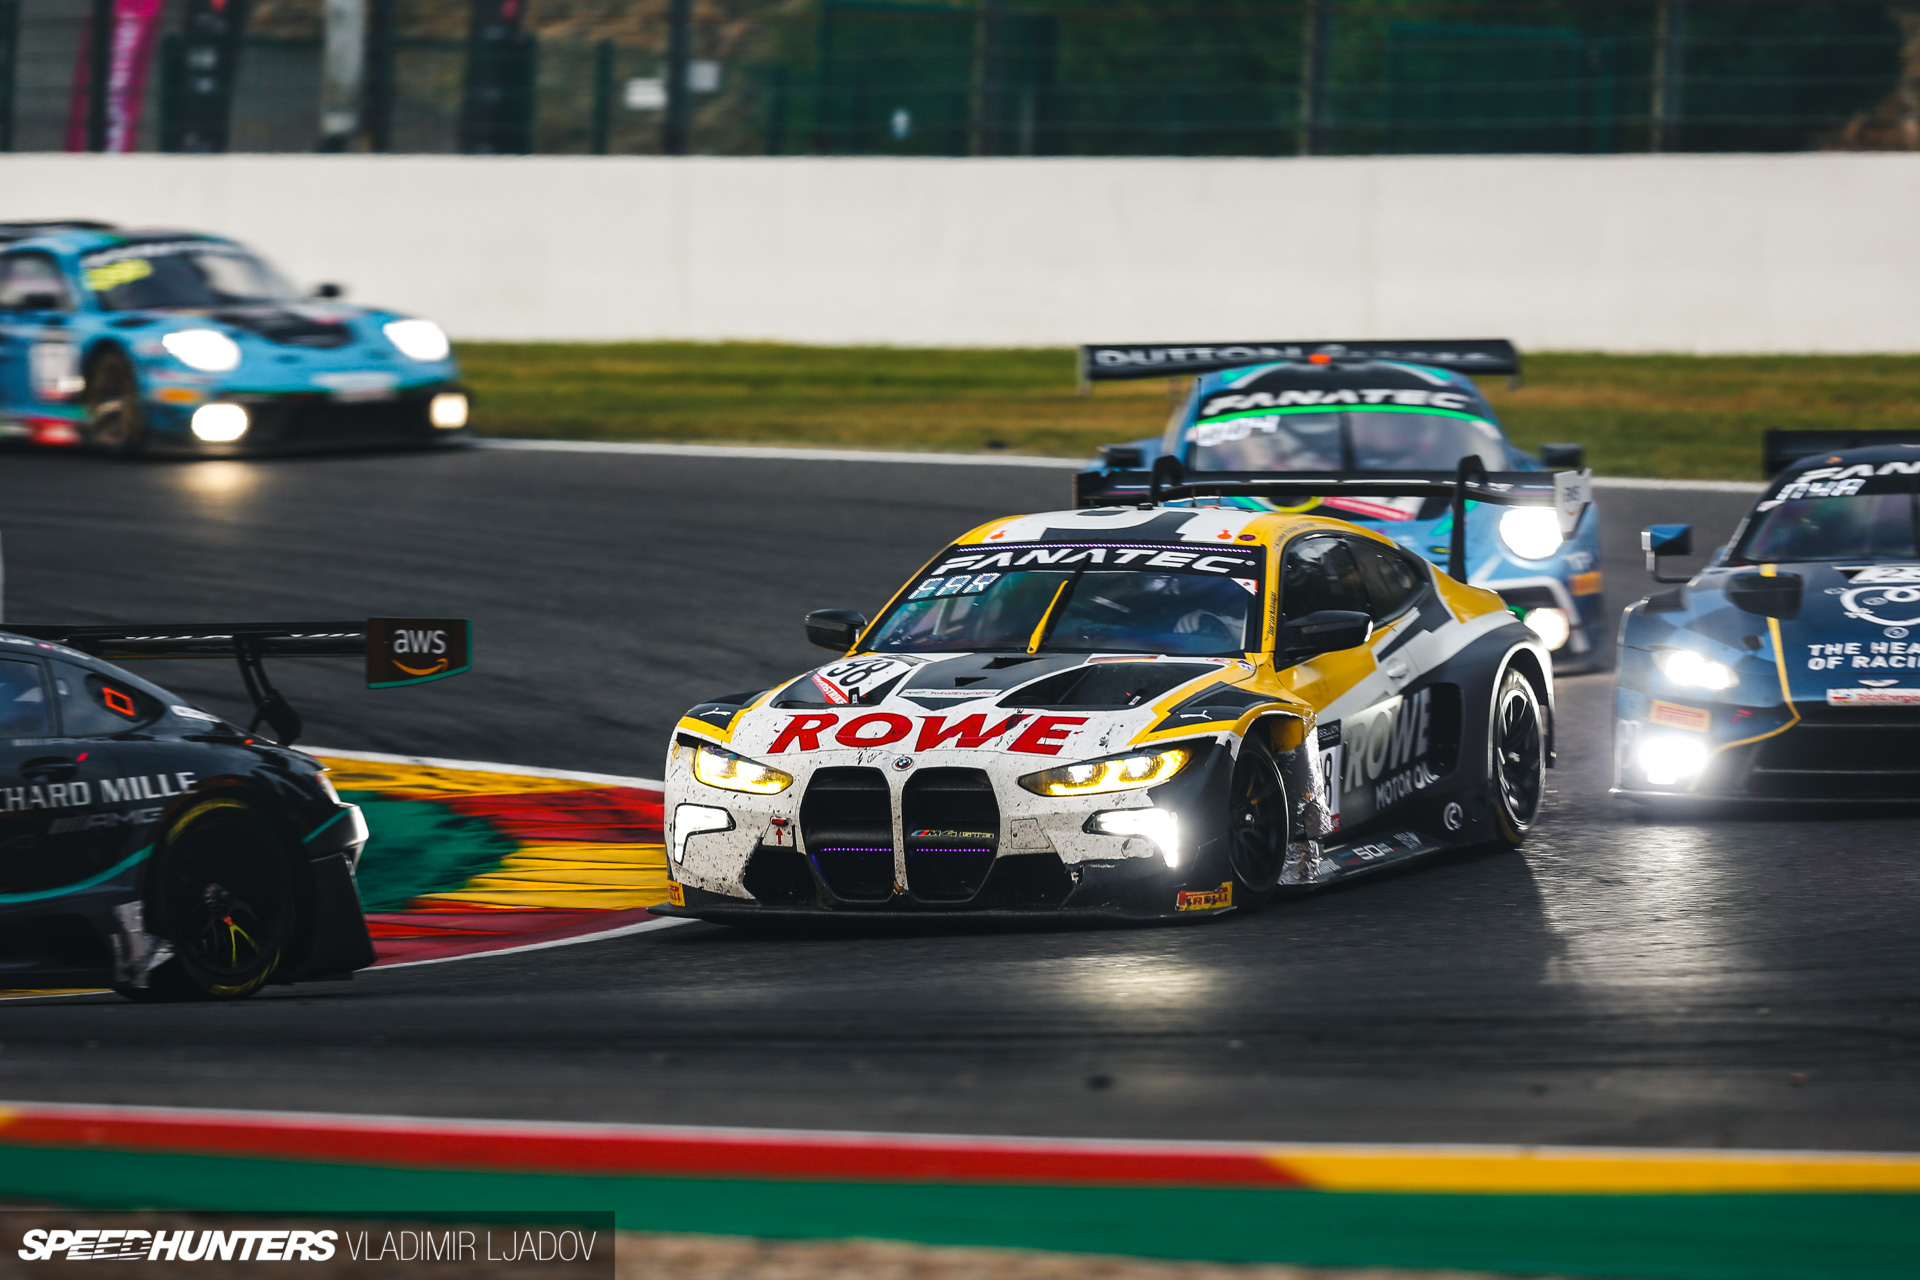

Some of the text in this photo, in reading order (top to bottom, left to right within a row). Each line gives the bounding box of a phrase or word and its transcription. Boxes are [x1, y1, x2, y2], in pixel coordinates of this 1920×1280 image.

[1095, 346, 1303, 367] DUTTON
[1202, 389, 1471, 416] FANATEC
[931, 549, 1247, 576] FANATEC
[908, 572, 1001, 600] FAR
[393, 629, 448, 654] aws
[1807, 642, 1862, 656] THE
[1807, 655, 1920, 671] OF RACI
[766, 712, 1091, 756] ROWE
[1344, 688, 1432, 794] ROWE
[100, 771, 198, 803] MILLE
[1375, 770, 1413, 811] MOTOR
